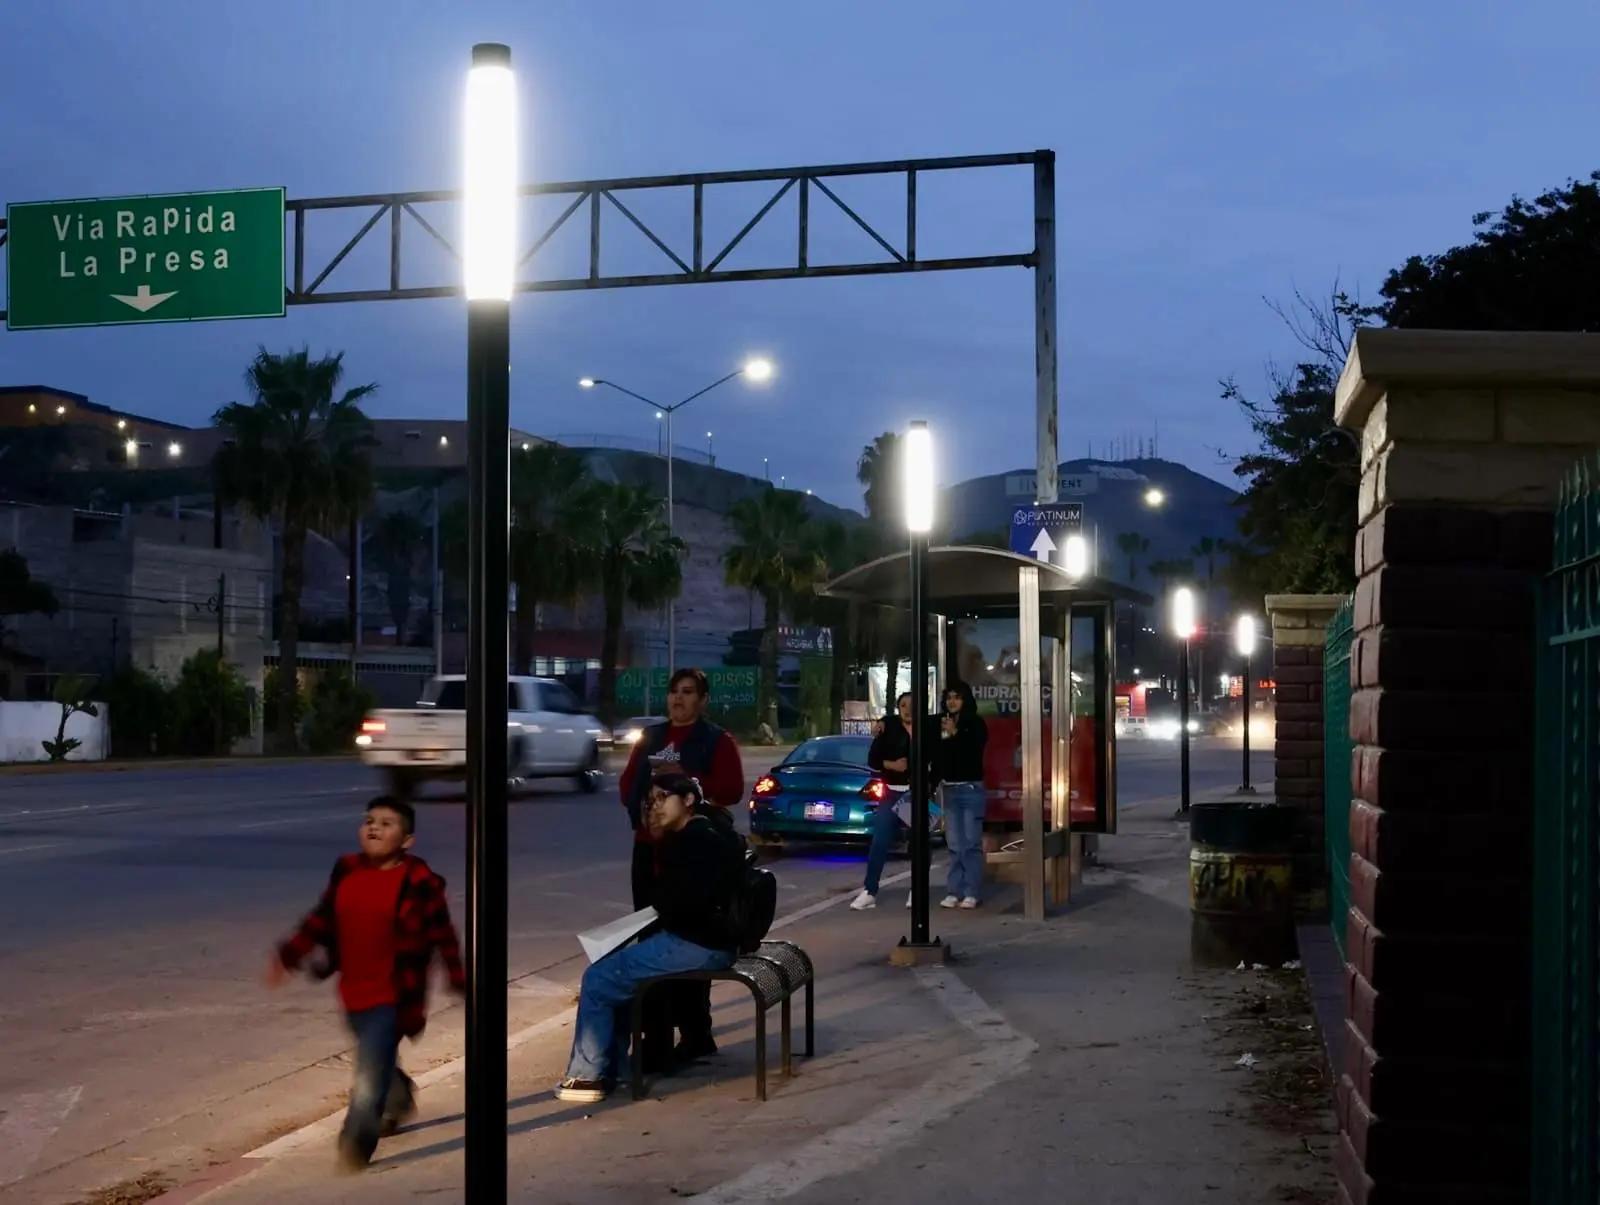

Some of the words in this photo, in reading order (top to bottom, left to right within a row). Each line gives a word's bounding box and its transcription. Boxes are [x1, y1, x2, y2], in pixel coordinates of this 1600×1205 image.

[53, 214, 104, 241] Via
[117, 205, 236, 238] Rapida
[60, 251, 98, 277] La
[120, 247, 229, 274] Presa
[1028, 510, 1080, 520] PLATINUM
[623, 671, 668, 688] OULE
[1000, 700, 1051, 713] TOL
